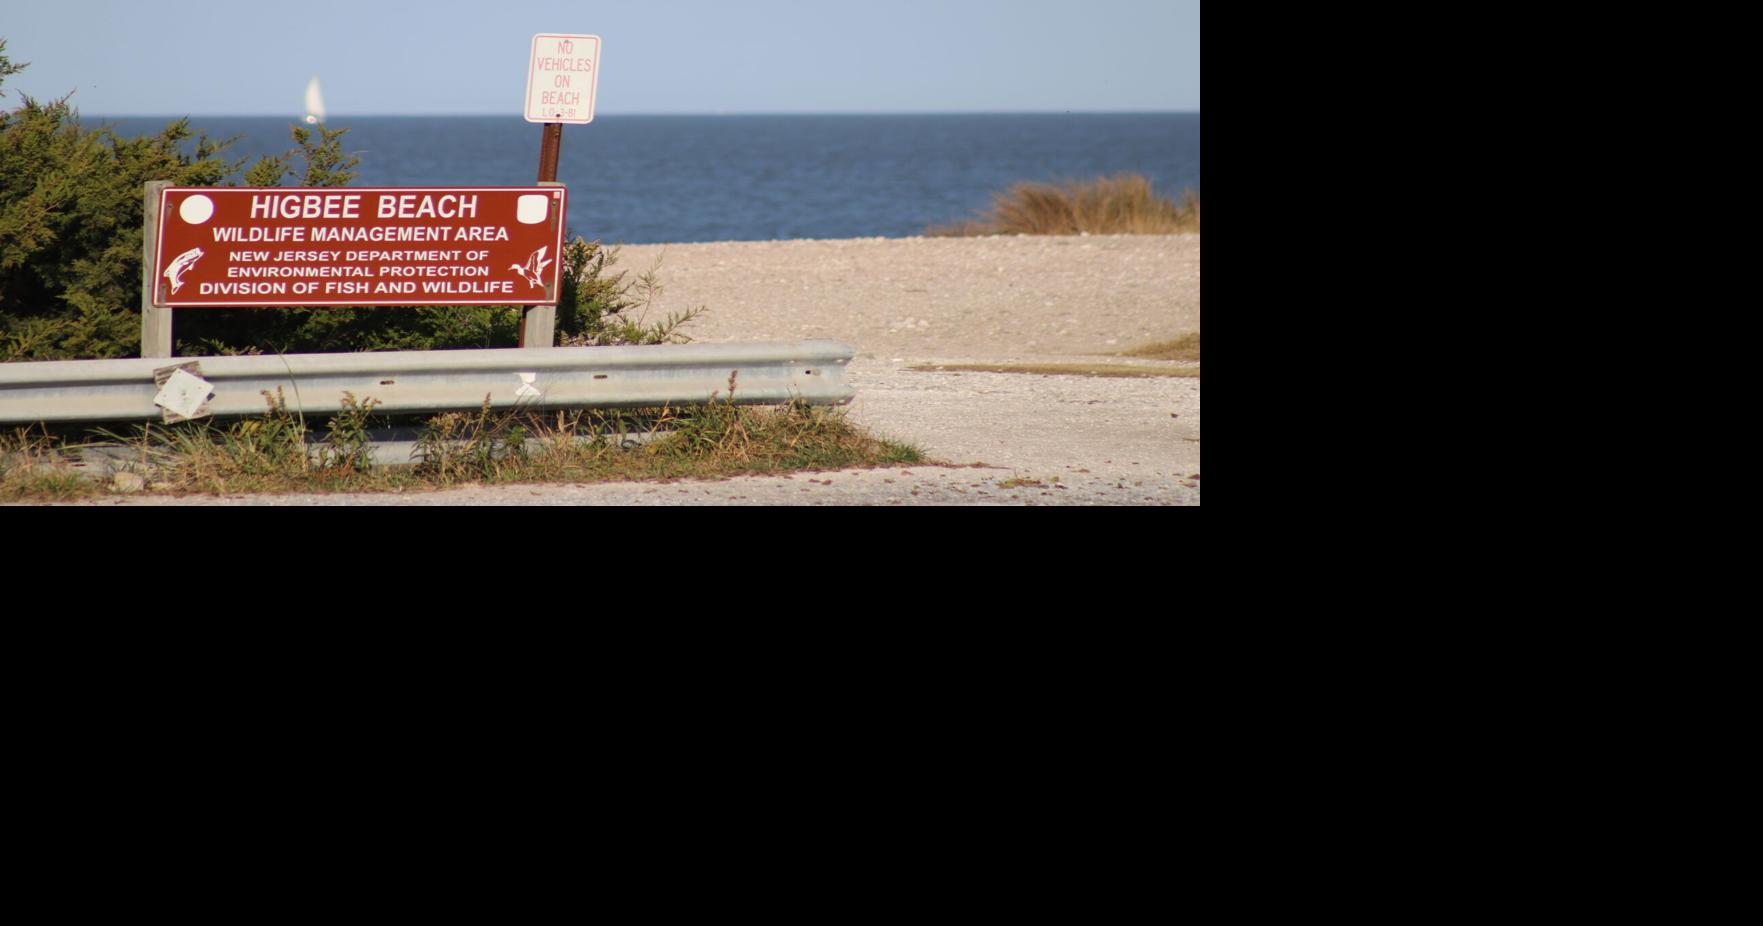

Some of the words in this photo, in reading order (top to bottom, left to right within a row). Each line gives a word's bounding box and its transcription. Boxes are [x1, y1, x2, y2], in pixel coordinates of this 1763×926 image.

[557, 41, 573, 54] NO
[537, 57, 592, 72] VEHICLES
[554, 74, 570, 88] ON
[541, 91, 580, 105] BEACH
[250, 194, 361, 219] HIGBEE
[377, 194, 478, 219] BEACH
[212, 226, 305, 242] WILDLIFE
[310, 226, 453, 242] MANAGEMENT
[453, 226, 509, 242] AREA
[229, 250, 270, 262] NEW
[273, 250, 341, 262] JERSEY
[345, 250, 462, 262] DEPARTMENT
[465, 250, 490, 261] OF
[227, 266, 374, 278] ENVIRONMENTAL
[379, 265, 489, 277] PROTECTION
[199, 282, 286, 295] DIVISION
[292, 281, 319, 295] OF
[325, 281, 369, 294] FISH
[373, 281, 417, 294] AND
[421, 280, 514, 294] WILDLIFE
